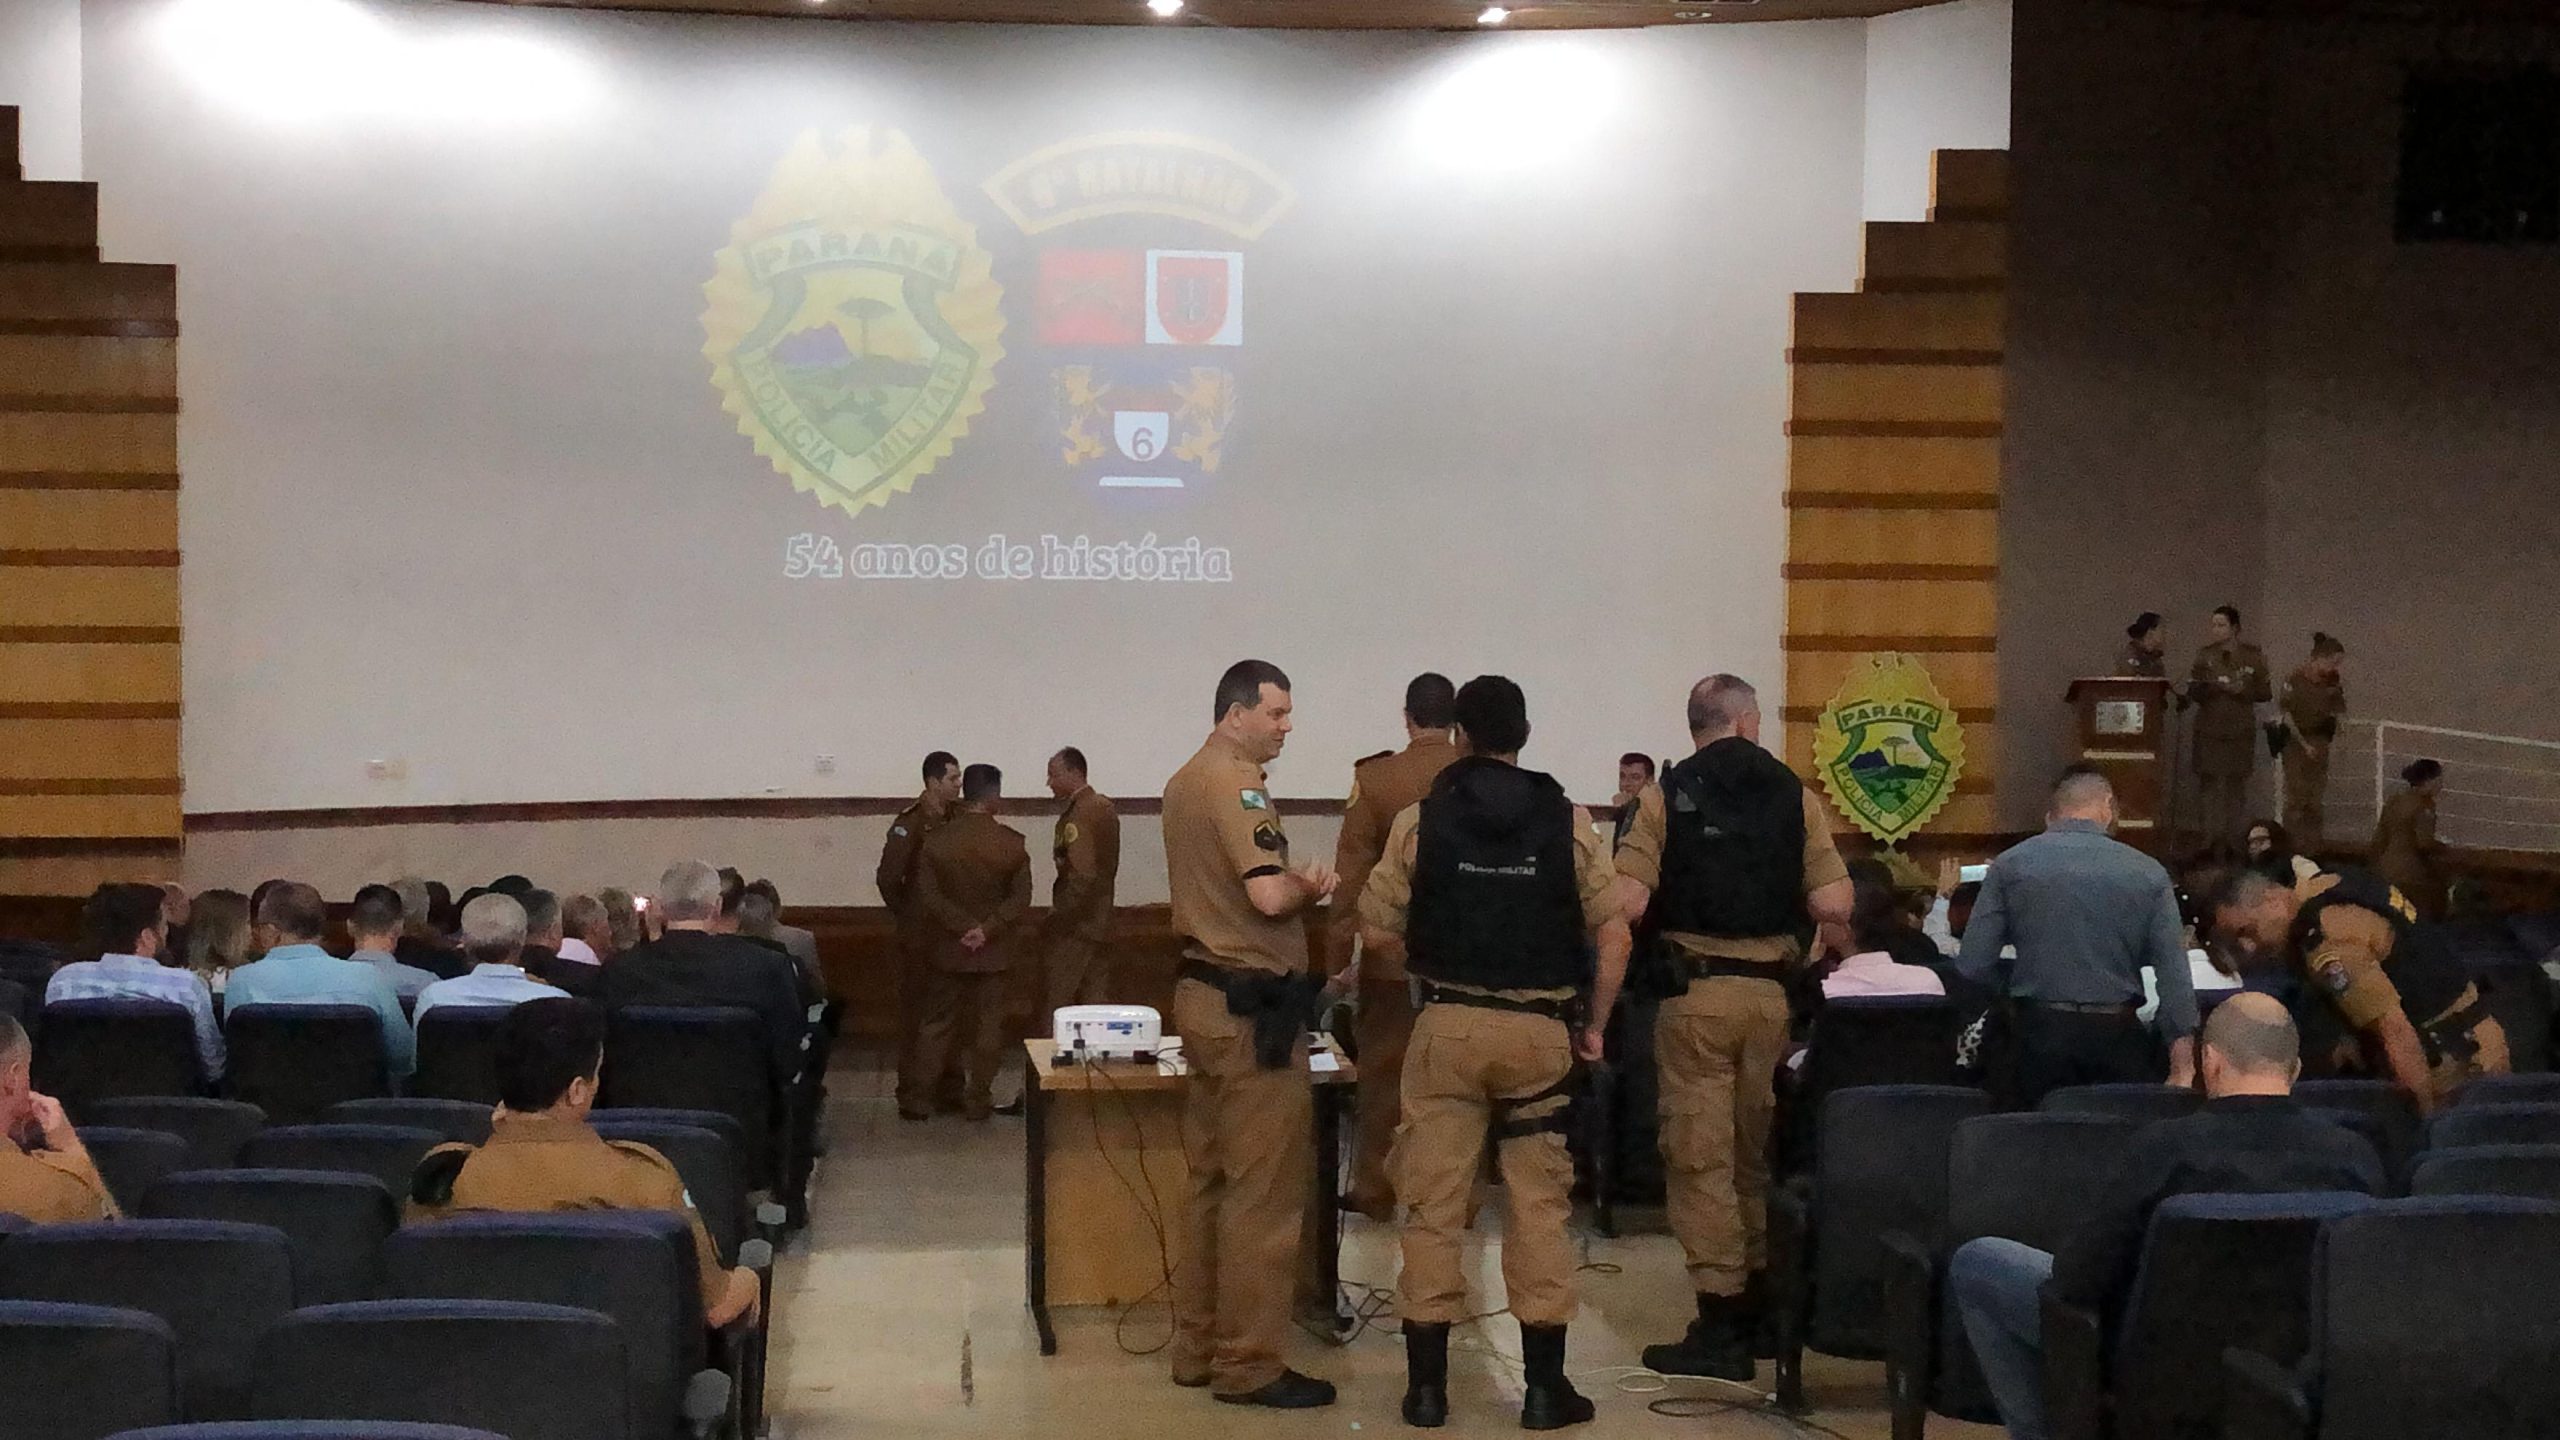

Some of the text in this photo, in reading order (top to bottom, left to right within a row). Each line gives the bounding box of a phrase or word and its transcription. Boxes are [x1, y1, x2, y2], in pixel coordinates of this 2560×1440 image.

[1132, 426, 1153, 460] 6
[783, 532, 1233, 581] 54 anos de história
